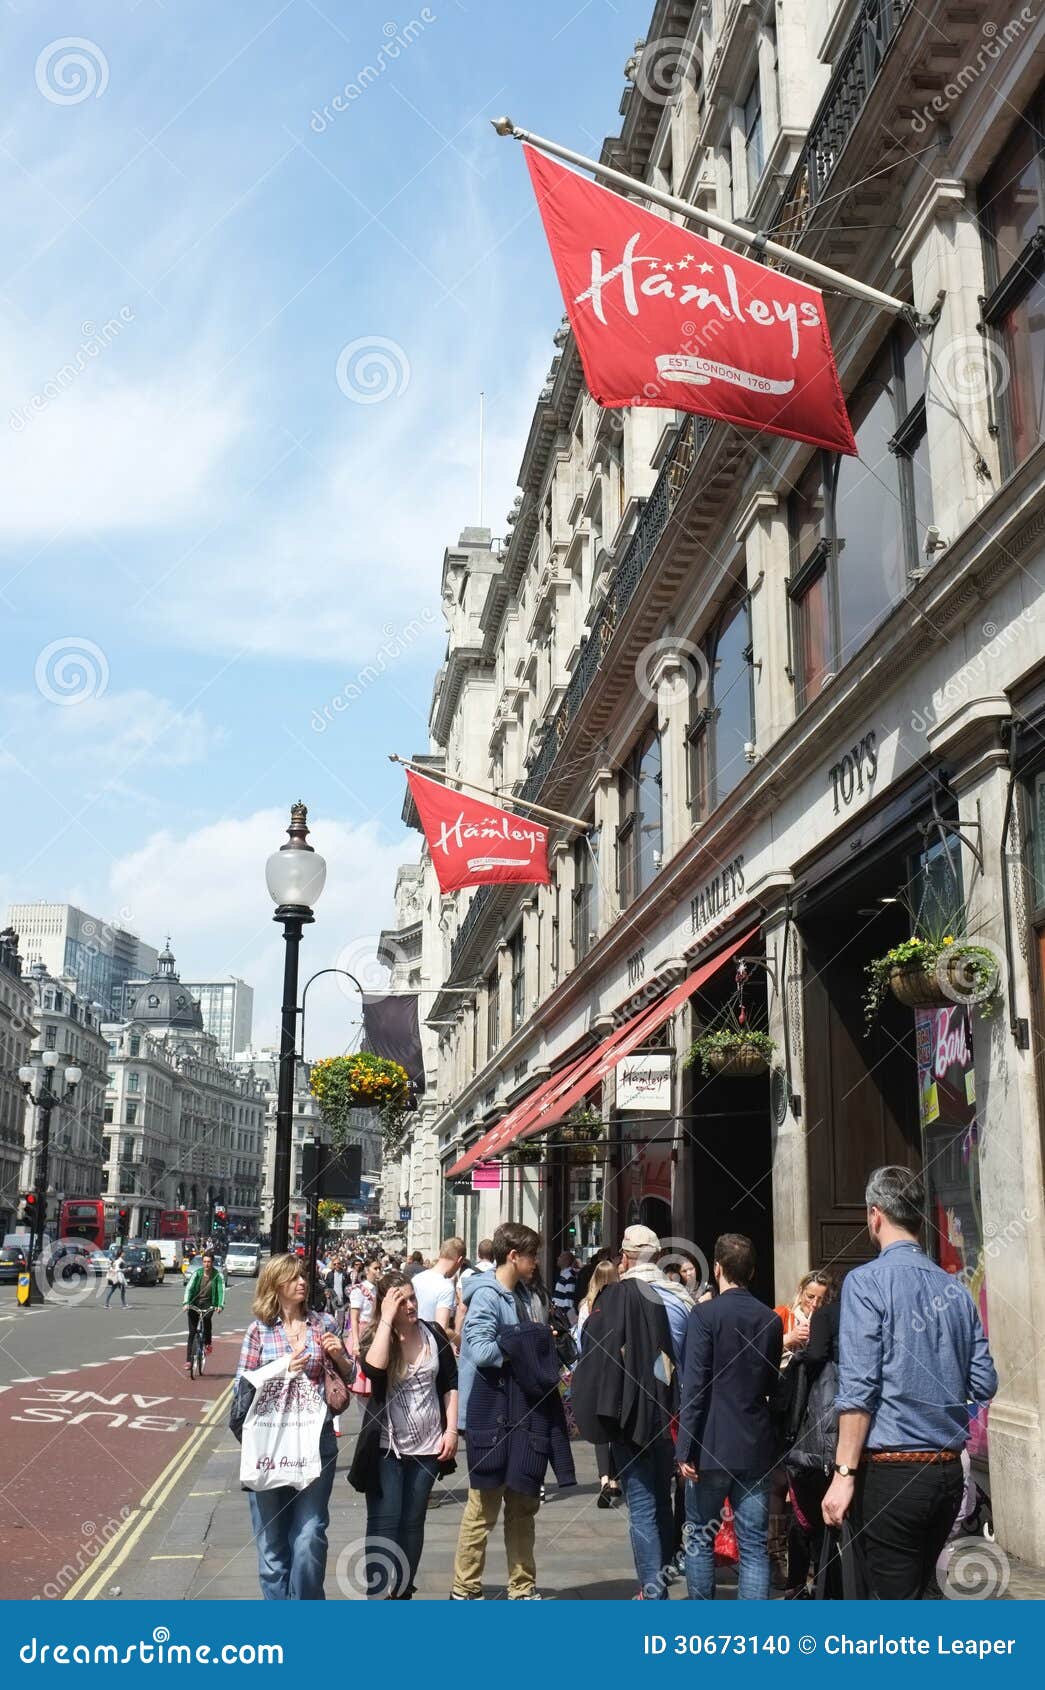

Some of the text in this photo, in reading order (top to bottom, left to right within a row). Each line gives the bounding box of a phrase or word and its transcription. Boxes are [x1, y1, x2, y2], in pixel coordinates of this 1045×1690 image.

[574, 232, 822, 360] Hamleys
[668, 357, 771, 391] EST. LONDON 1760
[828, 729, 878, 816] TOYS
[432, 811, 545, 855] Hamleys
[690, 854, 745, 936] HAMLEYS
[619, 1065, 669, 1092] Hamleys
[10, 1407, 186, 1432] BUS
